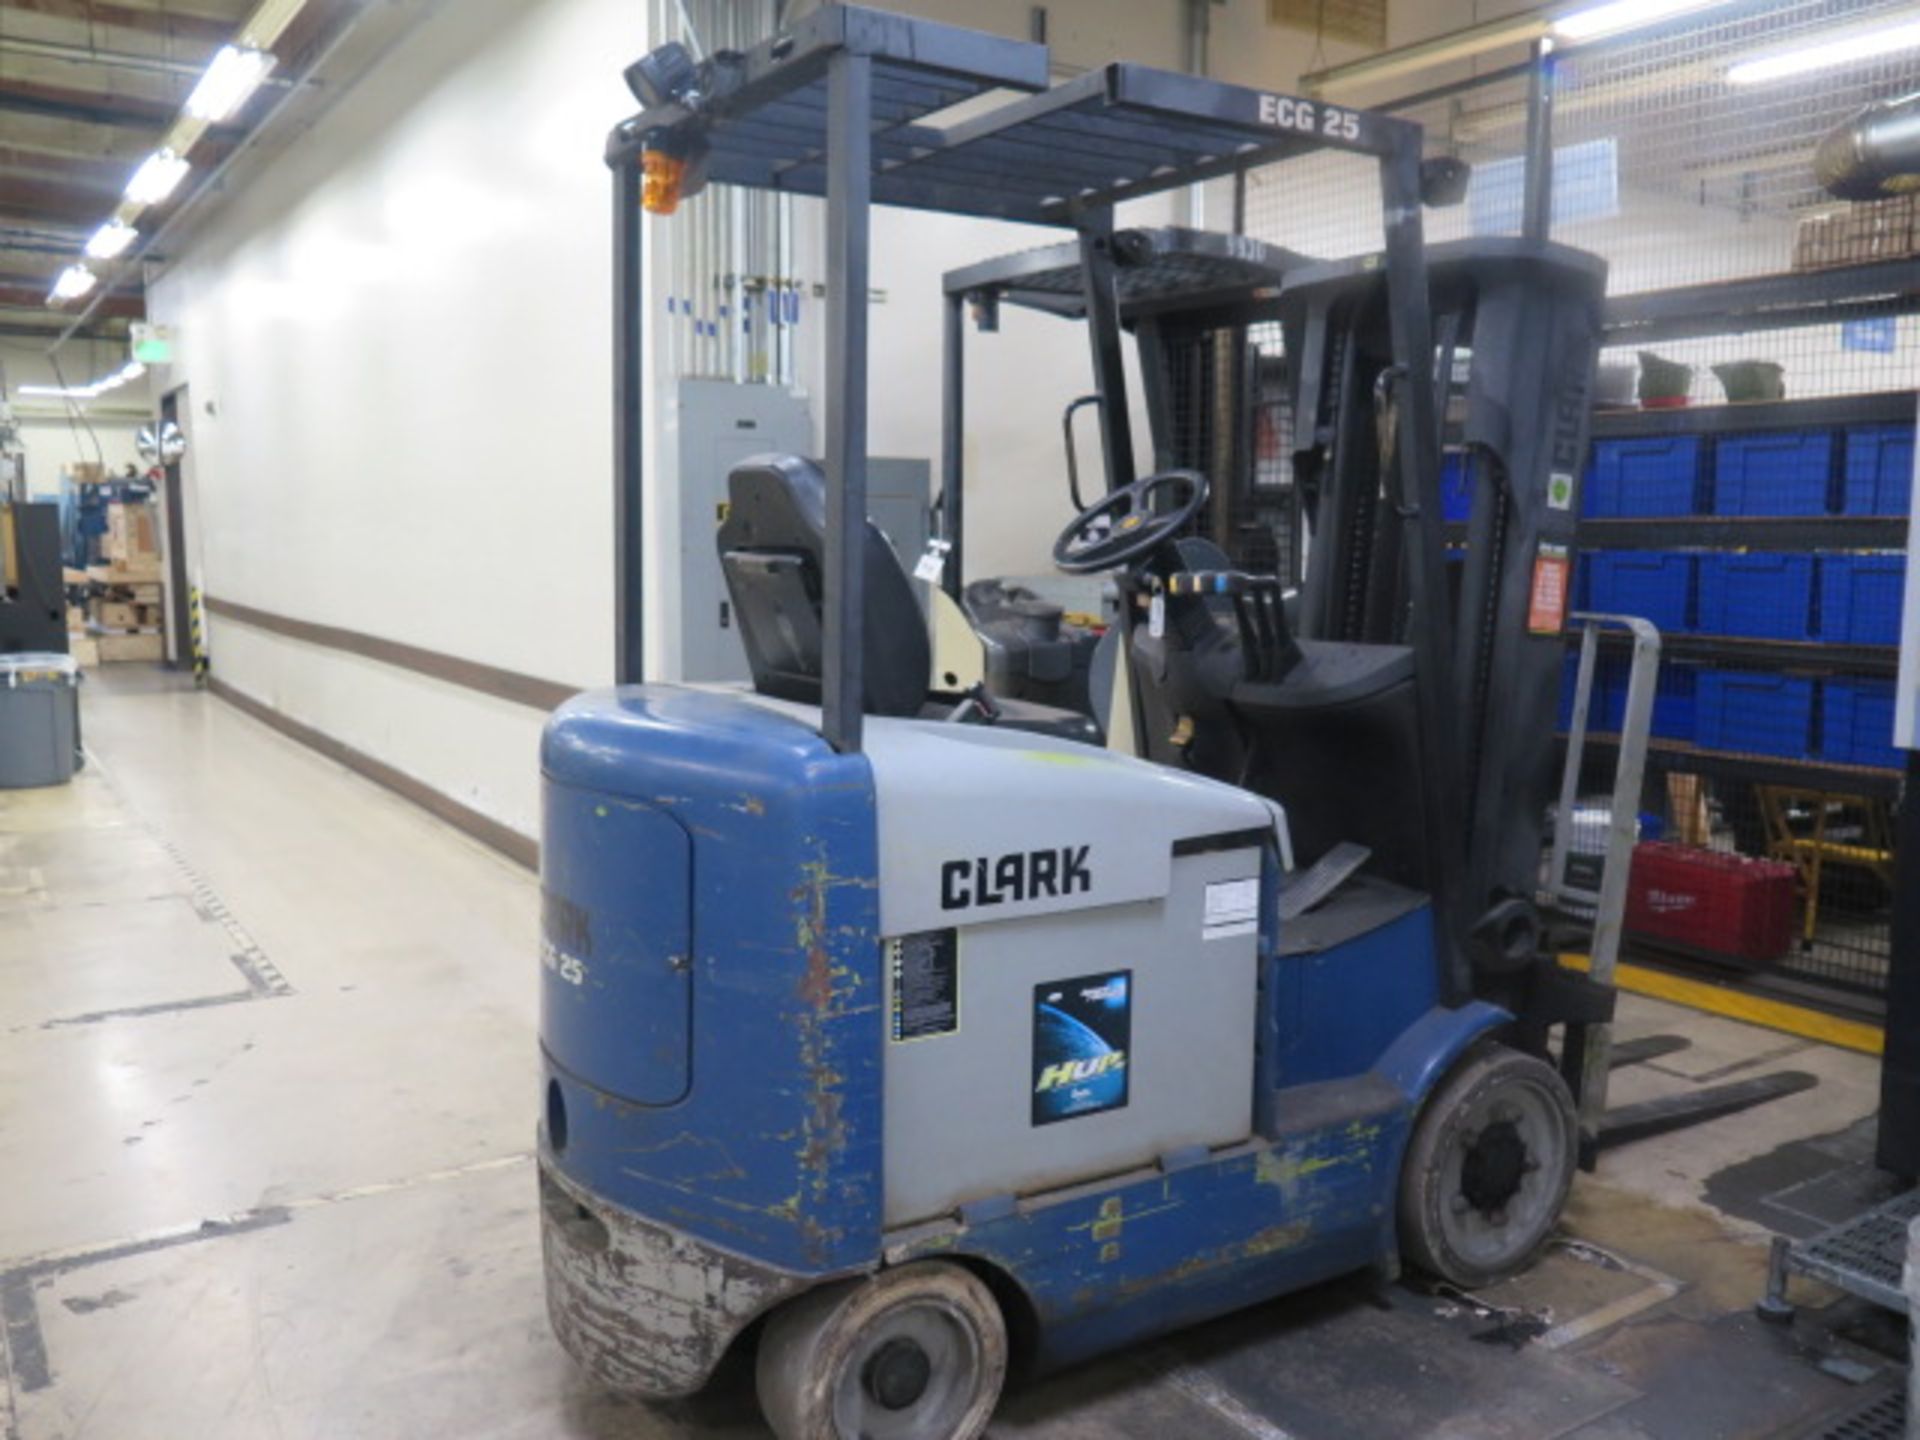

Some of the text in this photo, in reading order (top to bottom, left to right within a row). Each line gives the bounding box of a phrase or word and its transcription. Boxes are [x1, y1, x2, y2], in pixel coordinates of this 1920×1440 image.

[1258, 94, 1361, 140] ECG 25
[940, 844, 1091, 910] CLARK
